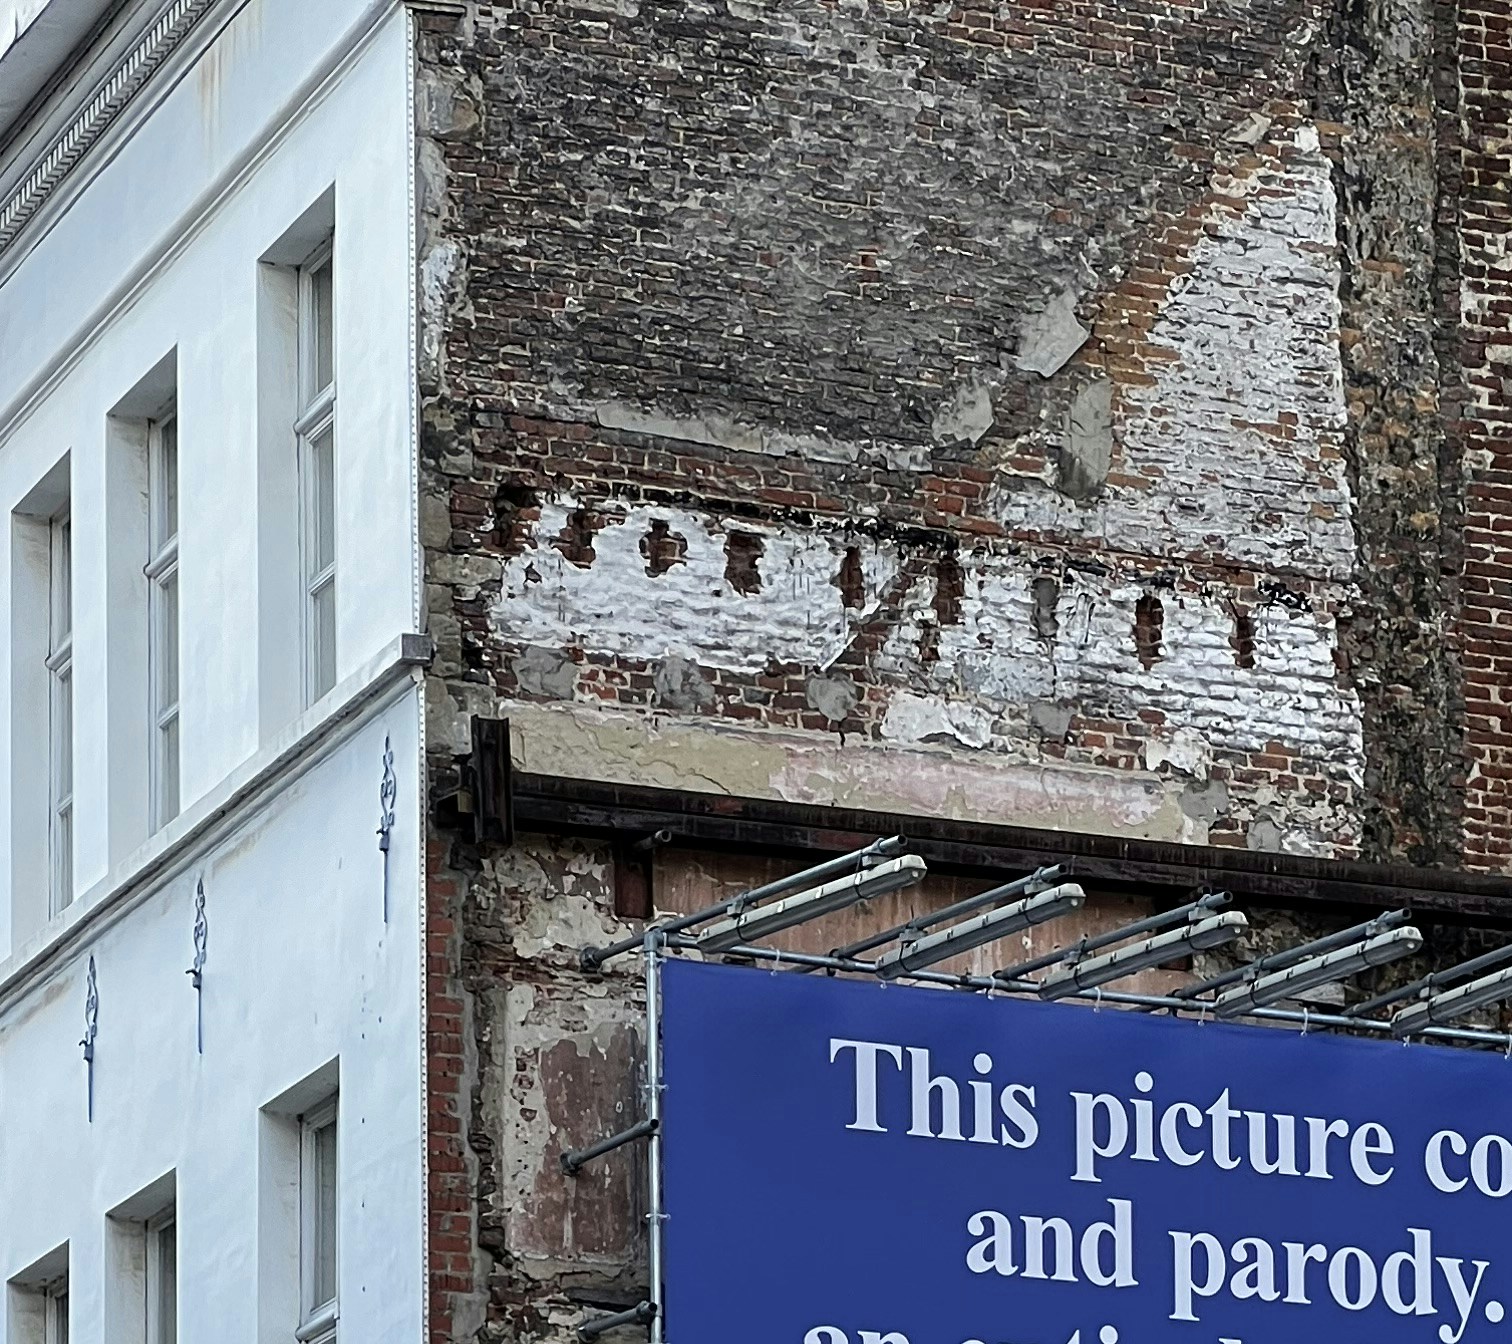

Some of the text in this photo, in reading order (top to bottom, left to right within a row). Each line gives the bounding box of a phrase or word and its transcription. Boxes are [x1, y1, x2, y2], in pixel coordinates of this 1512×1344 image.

[830, 1039, 1038, 1148] This
[1070, 1072, 1394, 1185] picture
[967, 1198, 1139, 1287] and
[1168, 1228, 1504, 1344] parody.
